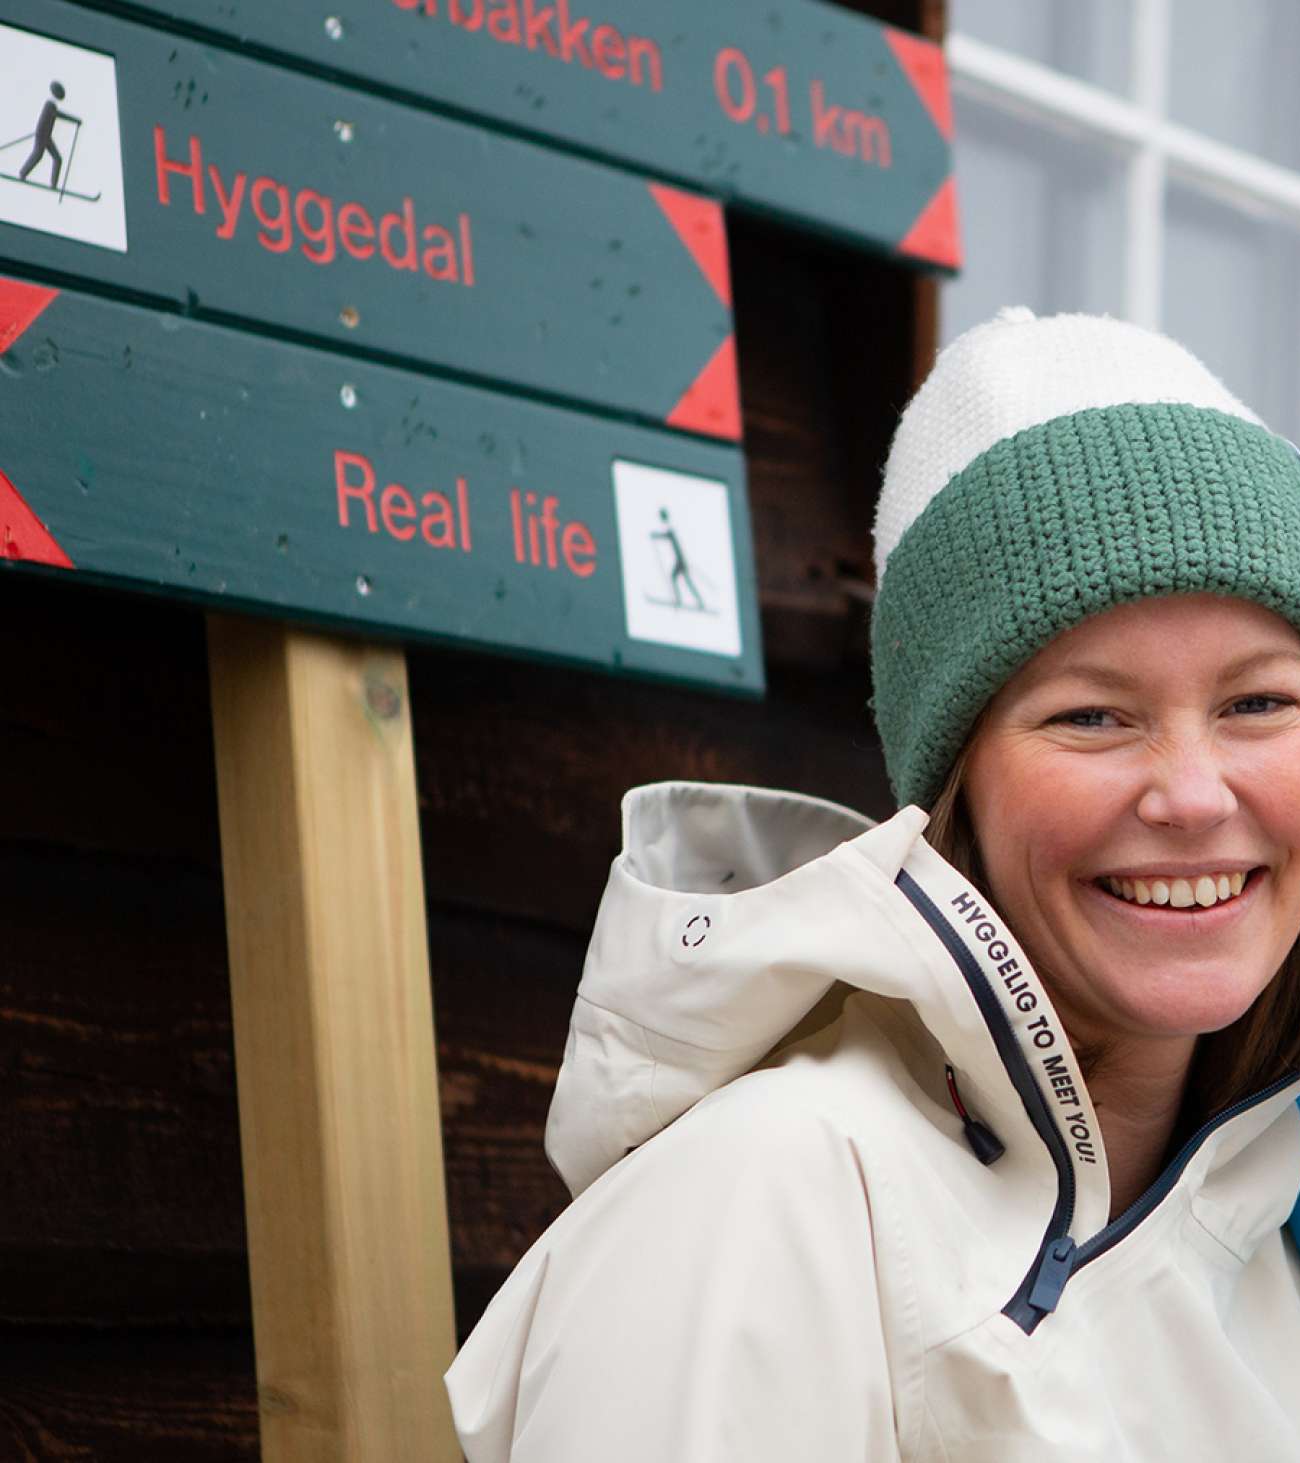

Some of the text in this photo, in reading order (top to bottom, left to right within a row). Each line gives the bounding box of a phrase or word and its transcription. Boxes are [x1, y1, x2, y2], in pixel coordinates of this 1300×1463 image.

[714, 47, 791, 135] 0.1
[811, 79, 892, 170] km
[153, 125, 475, 287] Hyggedal
[334, 450, 598, 578] Real life
[951, 891, 1097, 1165] HYGGELIG TO MEET YOU!
